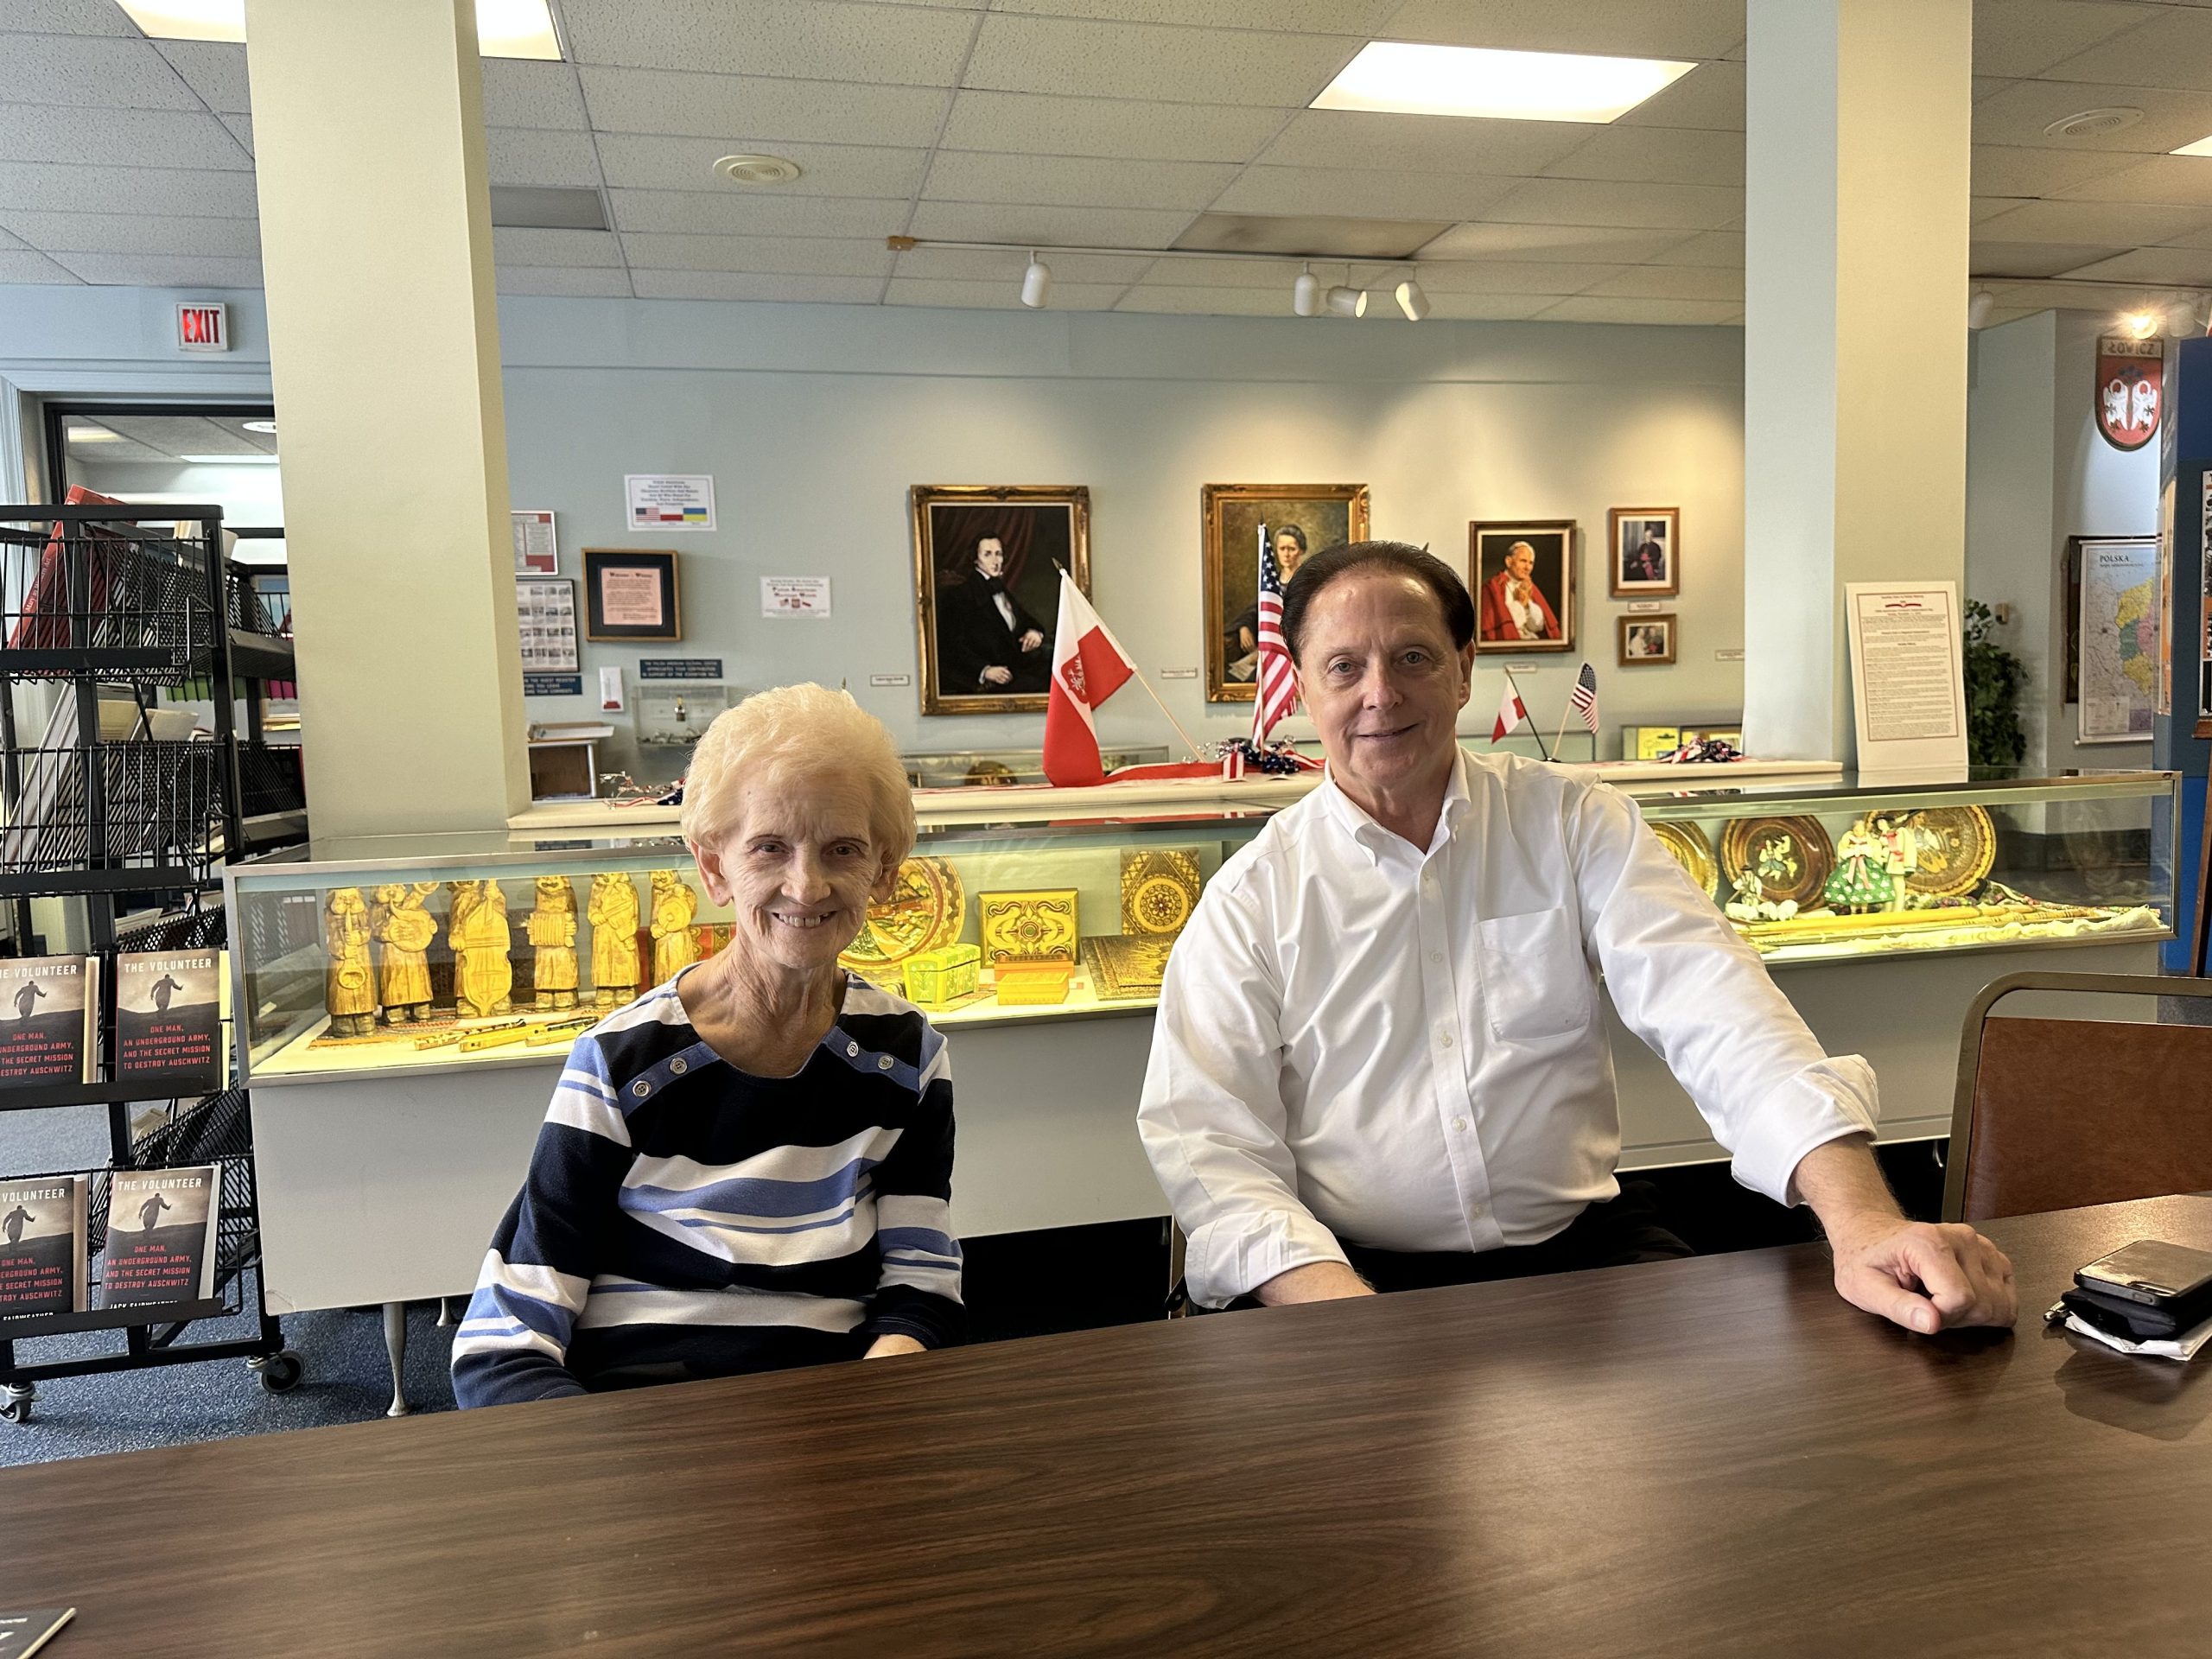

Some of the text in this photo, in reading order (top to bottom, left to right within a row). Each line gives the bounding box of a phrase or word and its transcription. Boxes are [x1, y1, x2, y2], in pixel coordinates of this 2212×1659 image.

[182, 308, 219, 343] EXIT
[15, 964, 77, 978] VOLUNTEER
[124, 958, 212, 973] THE VOLUNTEER
[13, 1033, 26, 1041] ONE
[136, 1035, 186, 1046] UNDERGROUND
[0, 1043, 48, 1052] NDERGROUND
[155, 1047, 180, 1056] SECRET
[135, 1059, 166, 1069] DESTROY
[168, 1056, 210, 1066] AUSCHWITZ
[0, 1065, 73, 1077] ESTROY AUSCHWITZ
[118, 1178, 202, 1191] THE VOLUNTEER
[3, 1188, 65, 1203] VOLUNTEER
[118, 1255, 168, 1265] UNDERGROUND
[0, 1268, 37, 1278] ERGROUND
[136, 1268, 161, 1276] SECRET
[162, 1267, 190, 1275] MISSION
[6, 1281, 32, 1290] SECRET
[35, 1279, 63, 1287] MISSION
[115, 1281, 146, 1289] DESTROY
[148, 1279, 189, 1287] AUSCHWITZ
[20, 1290, 62, 1300] AUSCHWITZ
